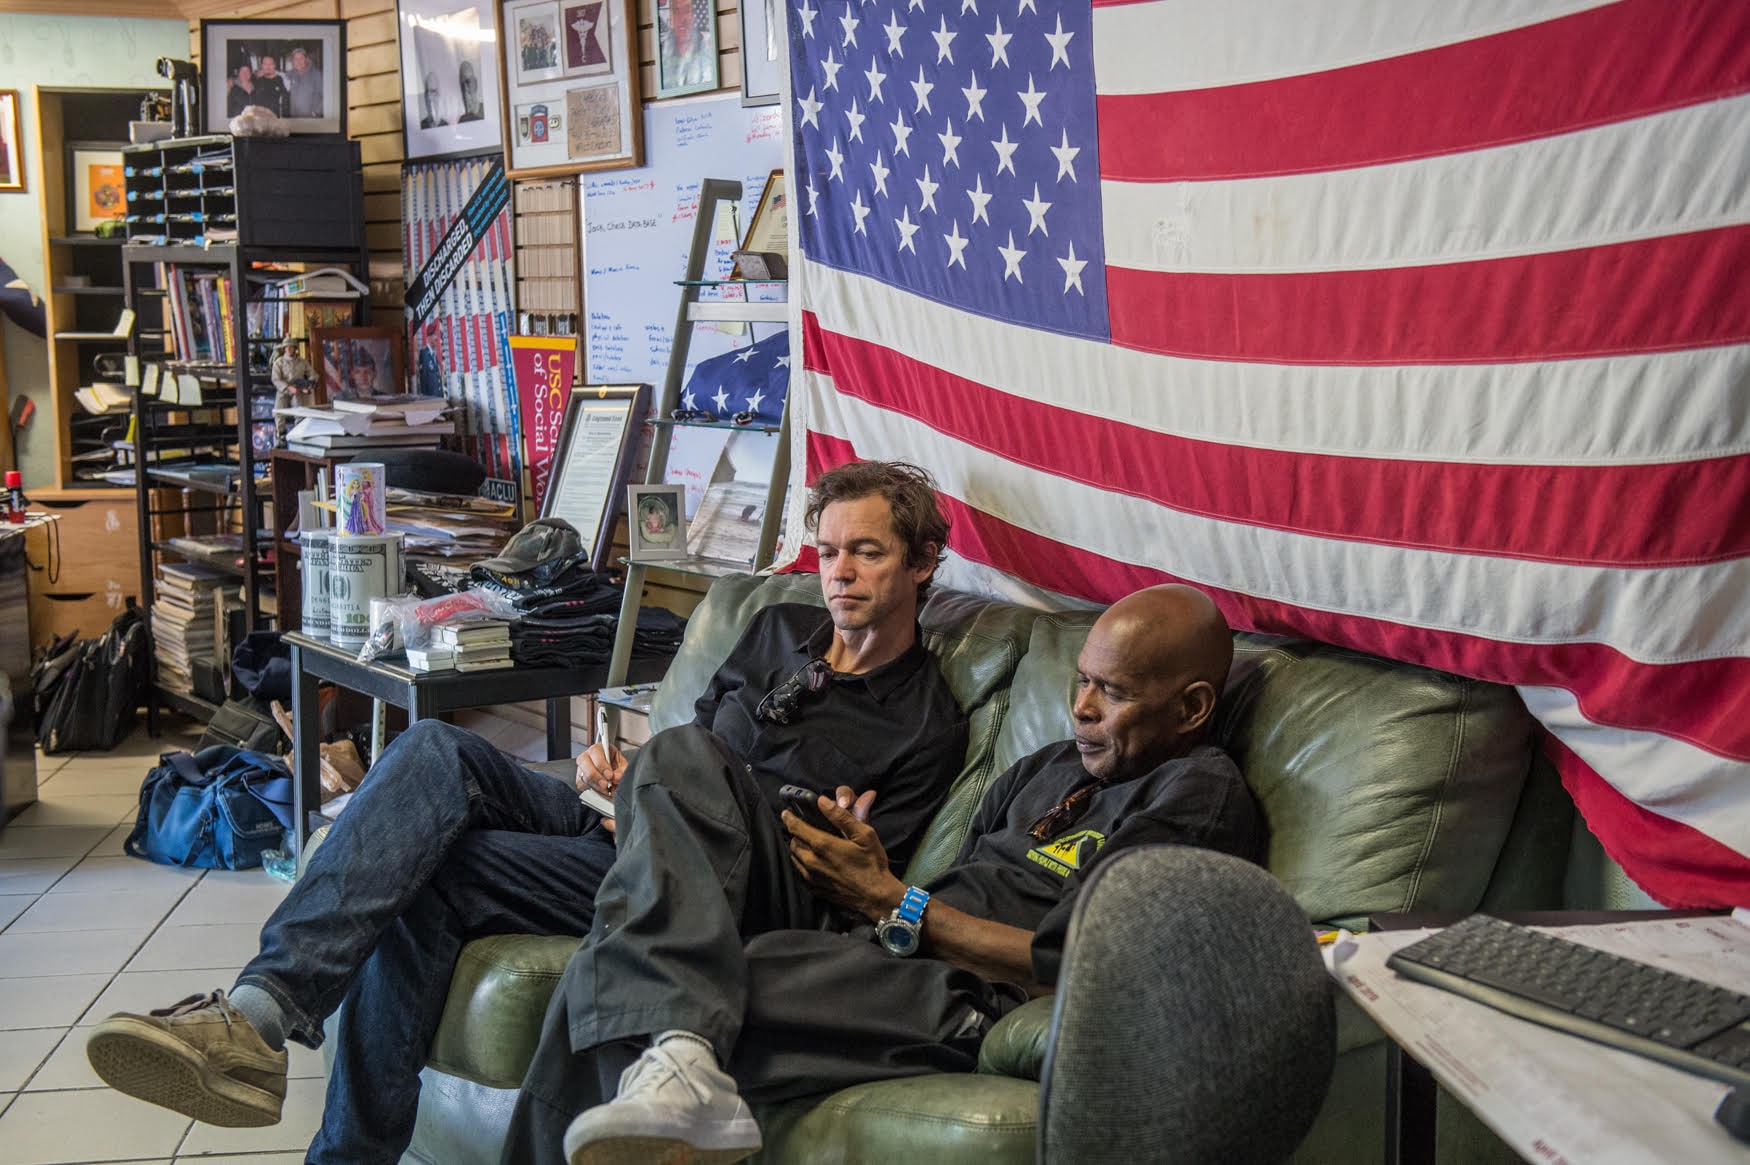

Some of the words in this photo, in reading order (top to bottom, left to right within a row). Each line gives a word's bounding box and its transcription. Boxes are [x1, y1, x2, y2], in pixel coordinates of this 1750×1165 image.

[416, 288, 435, 320] THEN
[434, 231, 473, 294] DISCARDED
[423, 218, 469, 288] DISCHARGED,
[534, 352, 547, 381] of
[548, 353, 562, 409] USC
[534, 384, 548, 452] Social
[490, 483, 515, 501] ACLU
[535, 455, 549, 509] Wor
